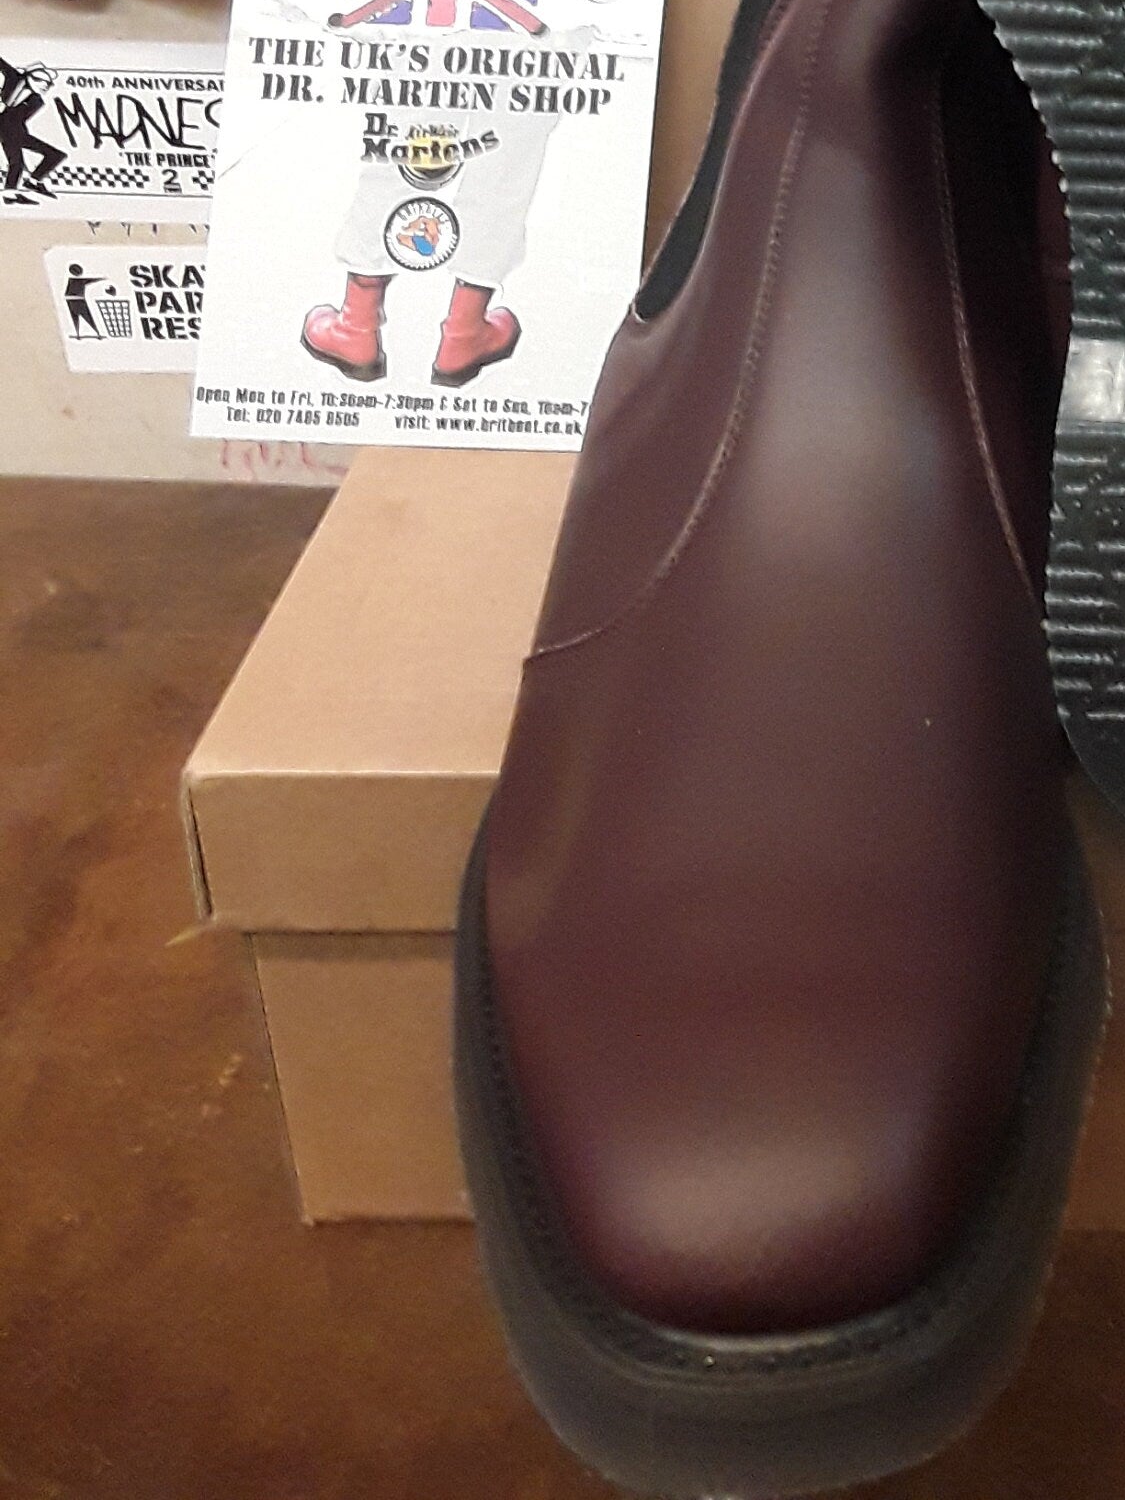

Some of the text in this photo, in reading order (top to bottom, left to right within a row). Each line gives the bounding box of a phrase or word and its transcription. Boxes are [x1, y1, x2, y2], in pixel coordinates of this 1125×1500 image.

[249, 37, 625, 82] THE UK'S ORIGINAL
[66, 76, 105, 88] 40th
[261, 72, 612, 115] DR. MARTEN SHOP
[360, 129, 500, 164] Martens
[196, 386, 230, 404] Open
[236, 388, 265, 405] Mon
[271, 390, 286, 405] to
[453, 397, 477, 413] Sat
[484, 398, 498, 413] to
[227, 406, 251, 423] Tel:
[256, 408, 281, 424] 020
[436, 417, 583, 435] www.britboot.co.uk
